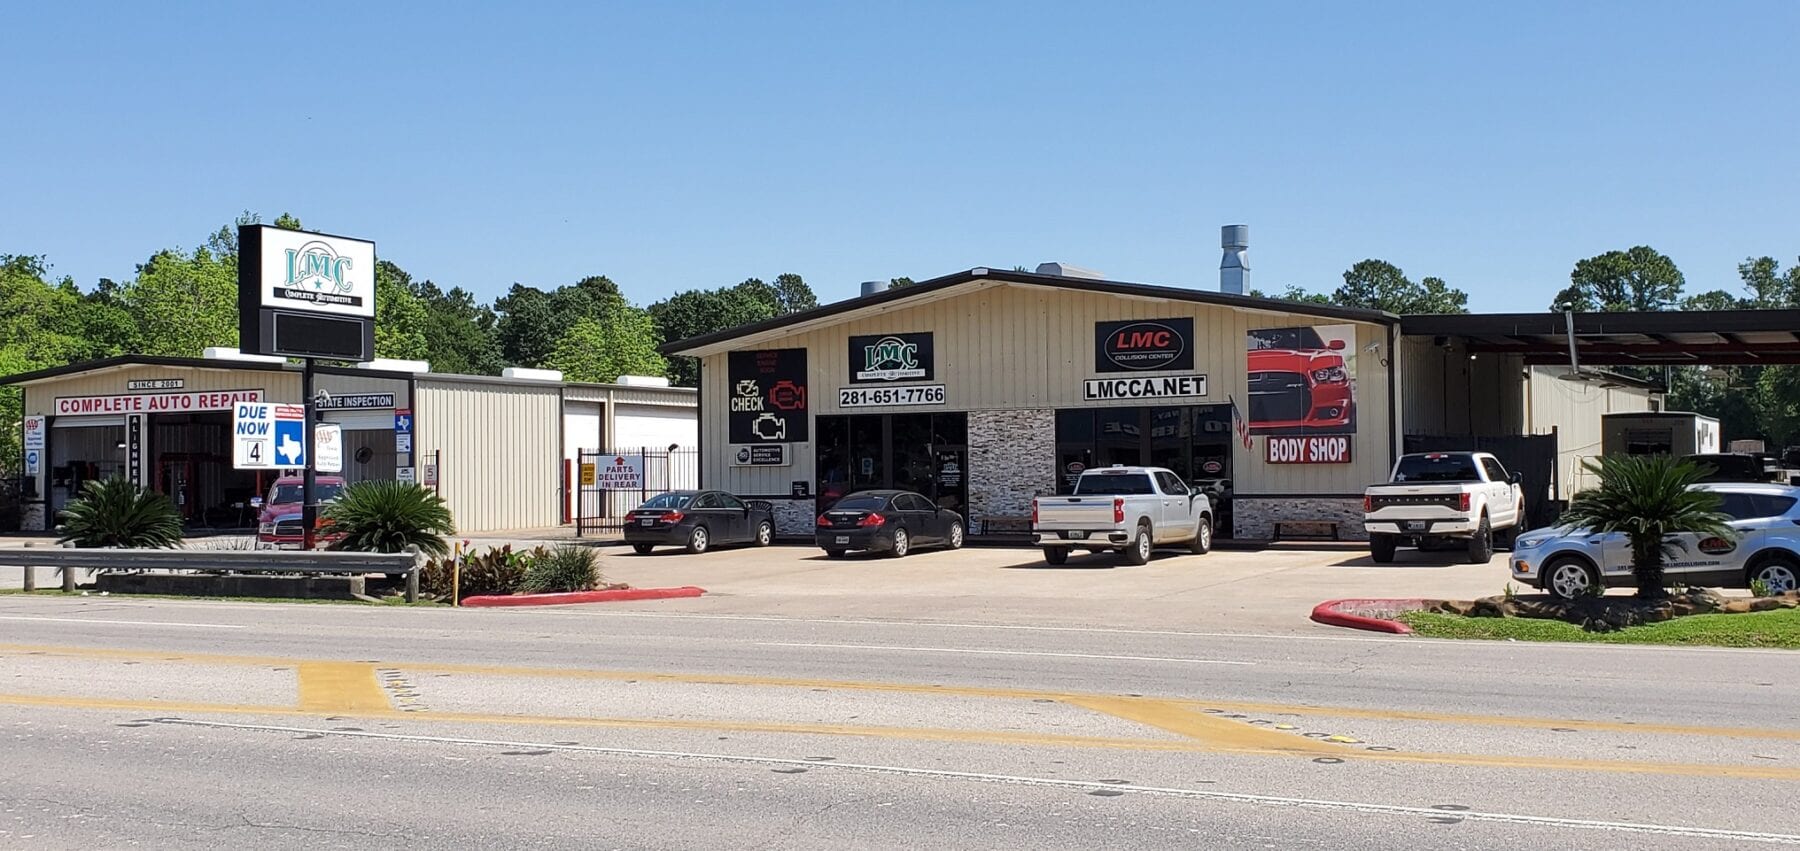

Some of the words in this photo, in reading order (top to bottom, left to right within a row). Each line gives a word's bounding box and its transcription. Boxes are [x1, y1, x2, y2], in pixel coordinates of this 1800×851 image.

[285, 249, 353, 293] LMC
[1116, 332, 1171, 349] LMC
[864, 344, 918, 371] LMC
[133, 381, 156, 389] SINCE
[161, 380, 179, 388] 2001
[1086, 377, 1205, 399] LMCCA.NET
[60, 397, 142, 413] COMPLETE
[148, 395, 191, 410] AUTO
[199, 393, 258, 408] REPAIR
[318, 398, 342, 407] STATE
[344, 395, 392, 407] INSPECTION
[731, 397, 764, 412] CHECK
[841, 388, 943, 405] 281-651-7766
[239, 405, 267, 419] DUE
[237, 422, 270, 435] NOW
[250, 442, 260, 462] 4
[1270, 438, 1306, 462] BODY
[1309, 438, 1347, 461] SHOP
[427, 468, 434, 477] 5
[598, 473, 641, 481] DELIVERY
